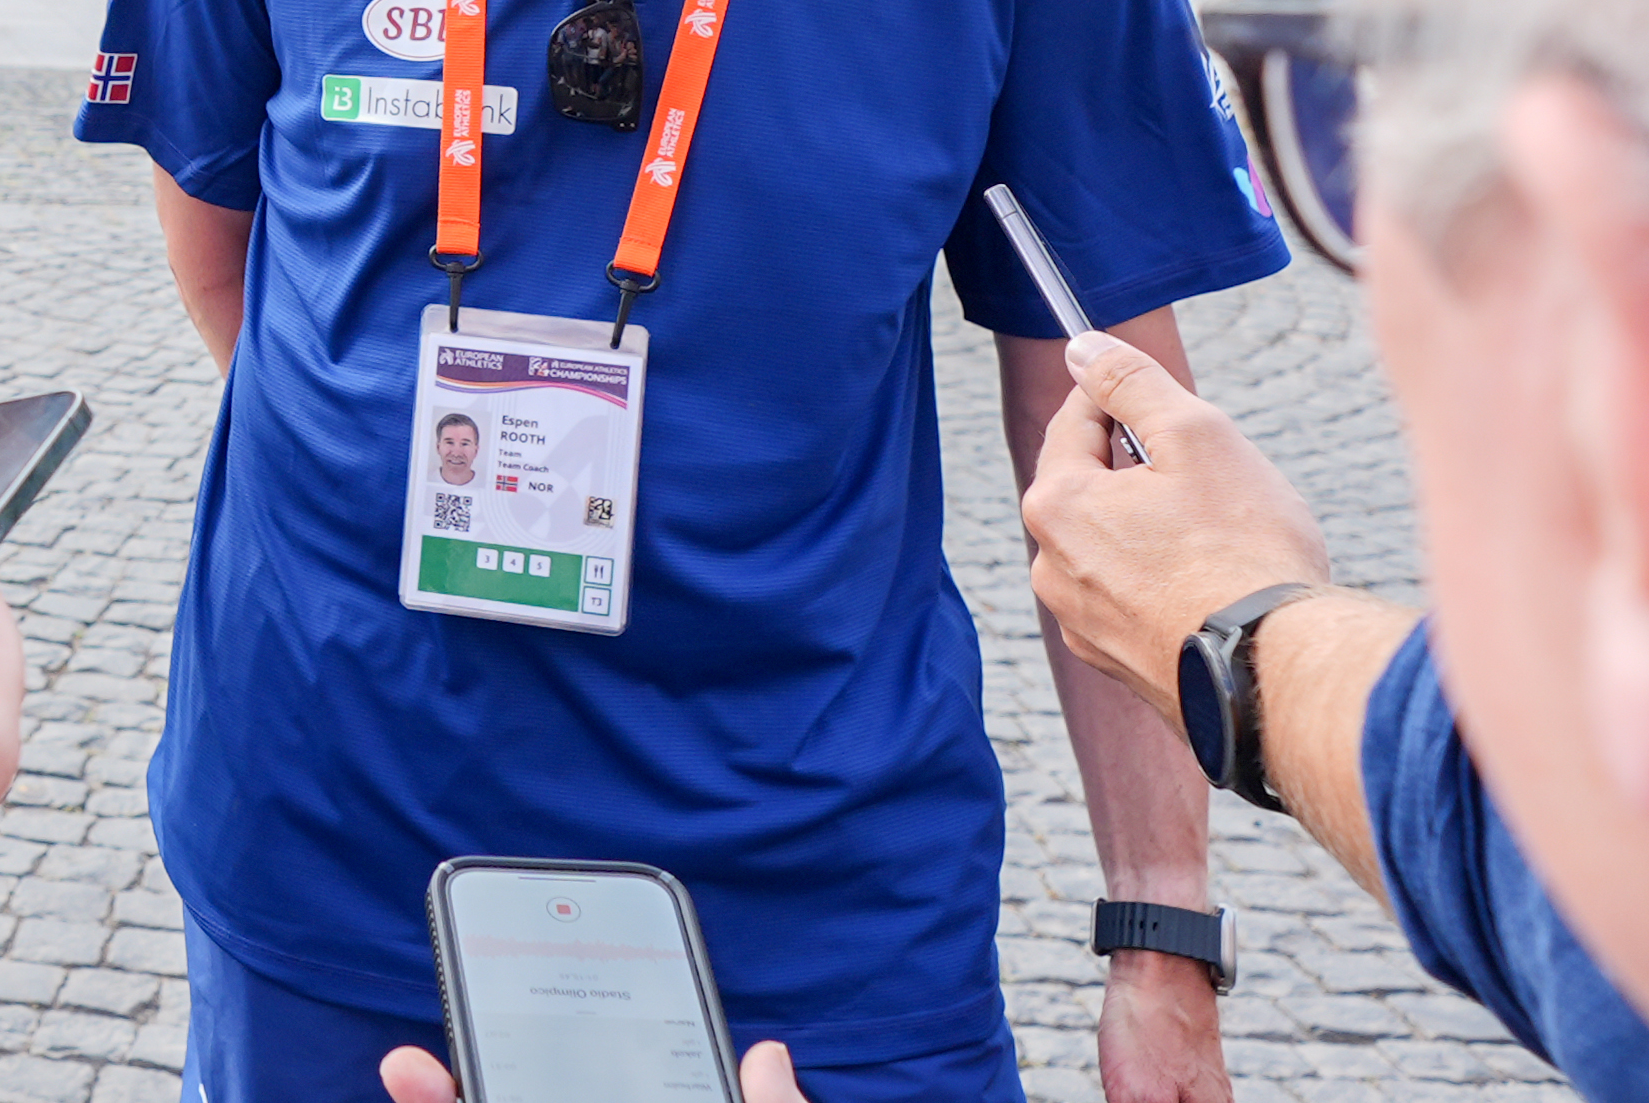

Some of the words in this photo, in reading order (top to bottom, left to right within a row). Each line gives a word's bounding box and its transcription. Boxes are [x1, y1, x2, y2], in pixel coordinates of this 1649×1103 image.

[367, 86, 513, 125] Instabnk
[453, 89, 463, 137] EUROPEAN
[461, 90, 471, 137] ATHLETICS
[657, 107, 677, 156] EUROPEAN
[666, 110, 685, 158] ATHLETICS
[455, 350, 504, 363] EUROPEAN
[454, 359, 503, 371] ATHLETICS
[550, 369, 627, 385] CHAMPIONSHIPS
[502, 415, 539, 429] Espen
[500, 431, 546, 445] ROOTH
[499, 448, 522, 458] Team
[498, 460, 521, 470] Team
[523, 463, 549, 473] Coach
[528, 481, 554, 493] NOR
[484, 555, 490, 564] 3
[510, 558, 516, 567] 4
[529, 987, 587, 999] Olimpico
[589, 989, 631, 1001] Stadio
